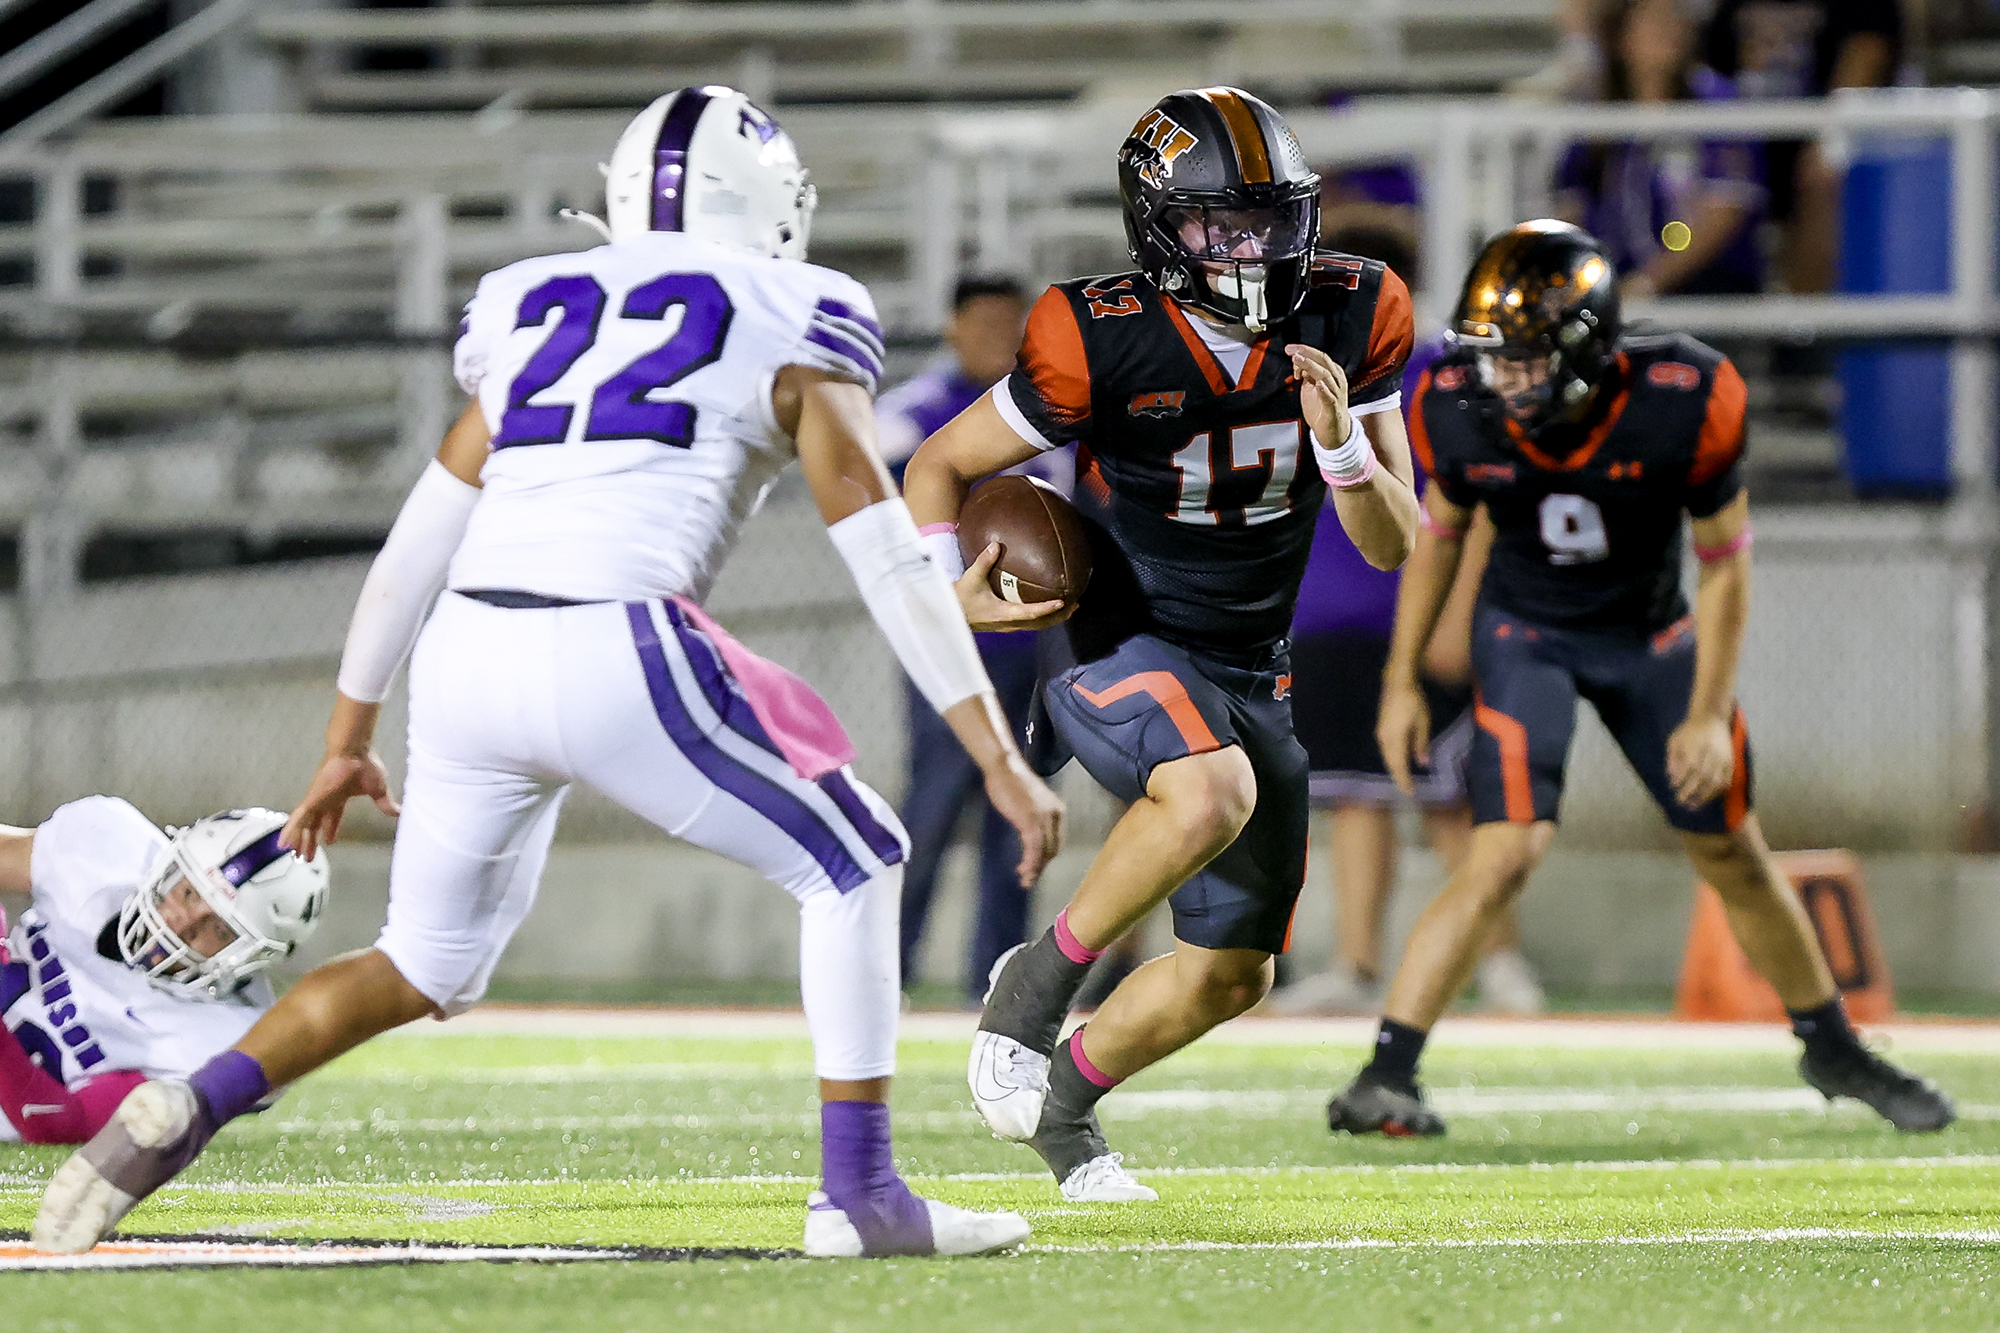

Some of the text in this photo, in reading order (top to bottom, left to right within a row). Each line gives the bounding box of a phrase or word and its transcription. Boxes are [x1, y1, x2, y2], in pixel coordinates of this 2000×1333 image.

[492, 271, 736, 450] 22
[1165, 419, 1301, 527] 17
[1537, 493, 1610, 566] 9
